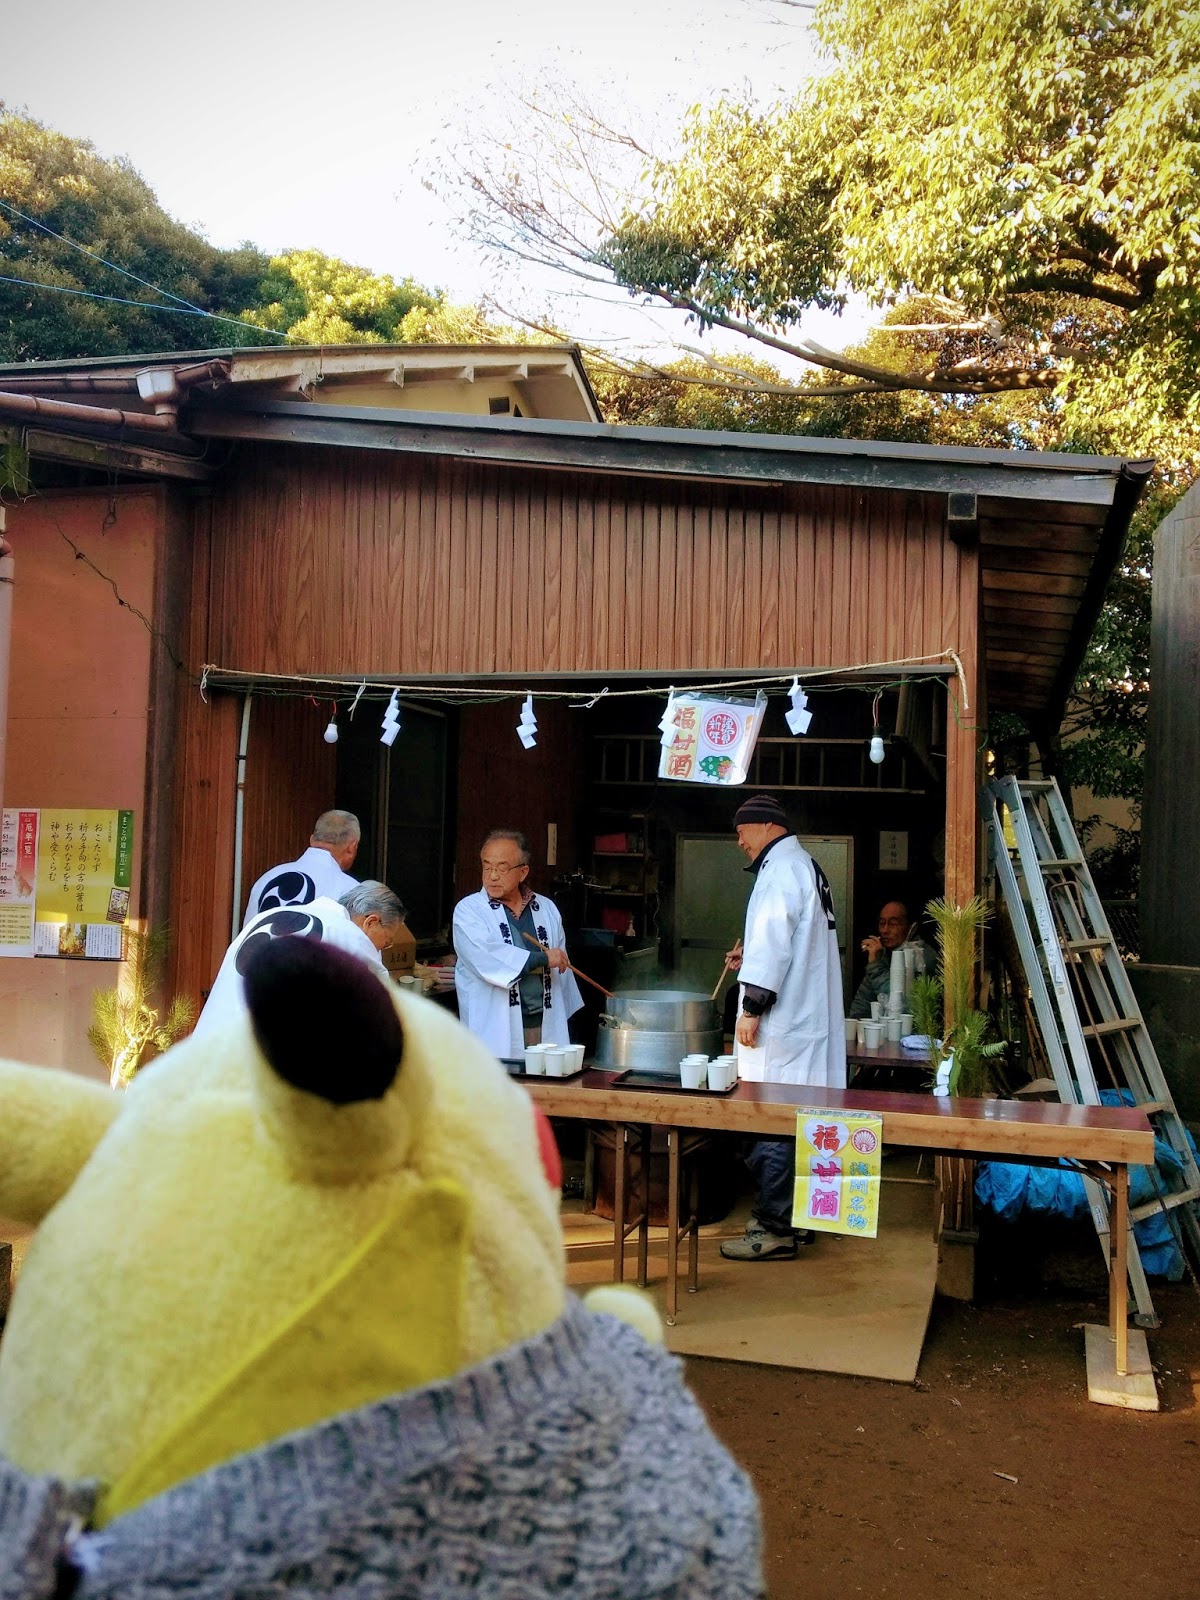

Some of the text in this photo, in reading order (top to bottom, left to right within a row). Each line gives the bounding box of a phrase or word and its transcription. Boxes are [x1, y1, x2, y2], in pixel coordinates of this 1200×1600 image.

[668, 706, 695, 778] 福甘酒
[24, 822, 33, 855] 厄年一覧
[93, 823, 102, 873] おこたらず
[812, 1124, 842, 1218] 福甘酒
[847, 1162, 871, 1231] 浅間名物
